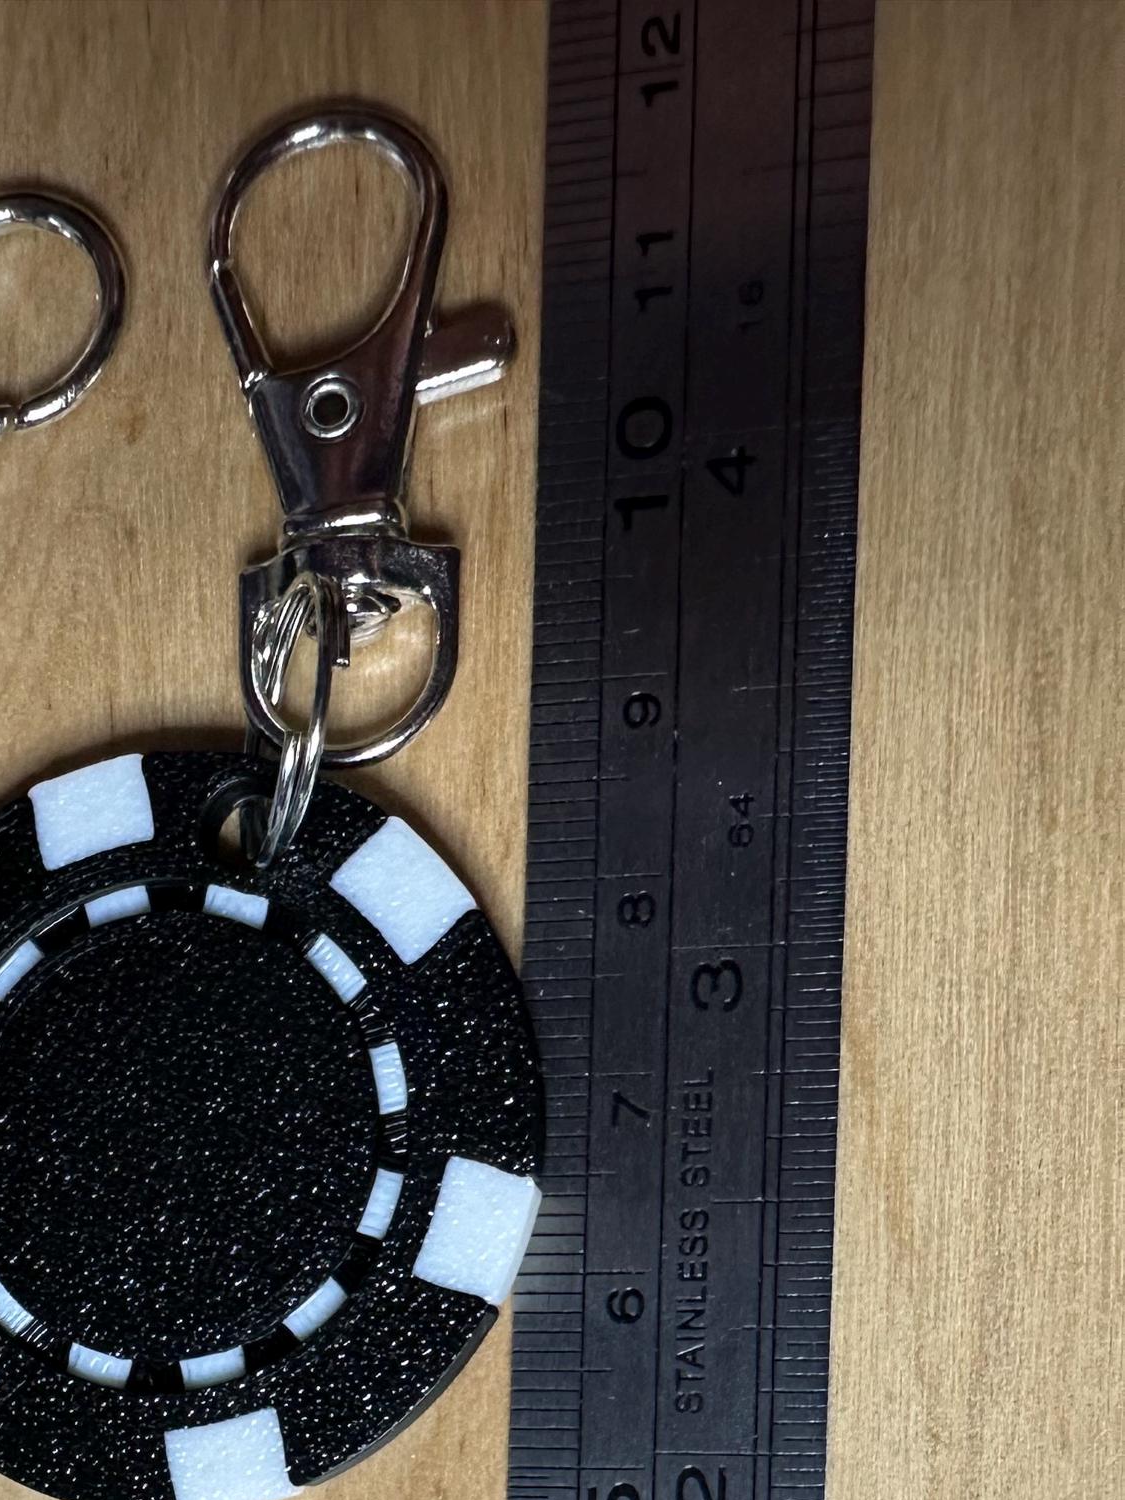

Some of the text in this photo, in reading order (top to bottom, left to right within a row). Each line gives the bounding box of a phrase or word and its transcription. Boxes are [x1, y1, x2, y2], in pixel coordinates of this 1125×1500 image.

[640, 12, 681, 107] 12
[635, 230, 674, 312] 11
[614, 396, 673, 531] 10
[705, 446, 758, 496] 4
[623, 692, 662, 729] 9
[728, 793, 755, 848] 64
[617, 891, 655, 928] 8
[691, 958, 743, 1012] 3
[610, 1089, 651, 1127] 7
[675, 1067, 714, 1414] STAINLESS STEEL
[606, 1287, 645, 1324] 6
